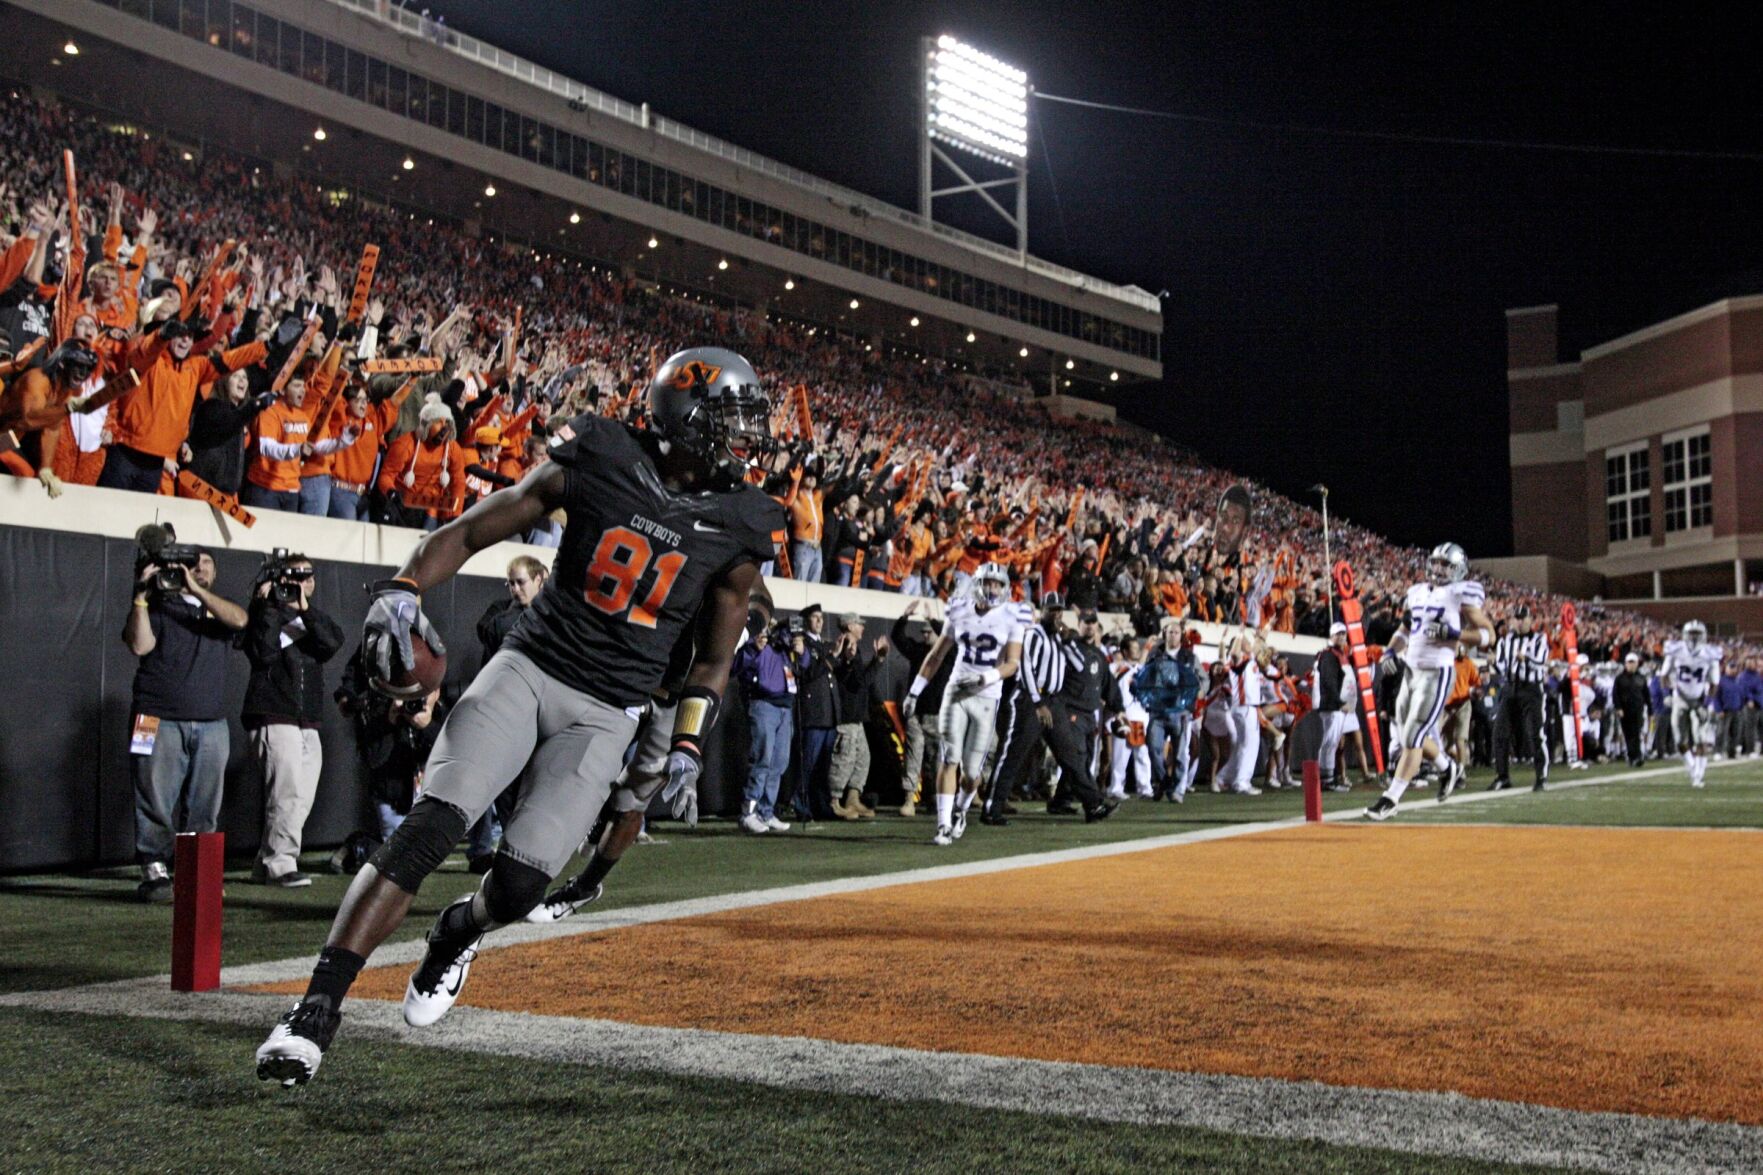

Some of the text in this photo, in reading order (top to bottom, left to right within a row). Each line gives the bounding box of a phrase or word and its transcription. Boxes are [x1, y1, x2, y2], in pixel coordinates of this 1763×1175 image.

[630, 513, 682, 547] COWBOYS
[583, 525, 688, 629] 81
[960, 631, 998, 668] 12
